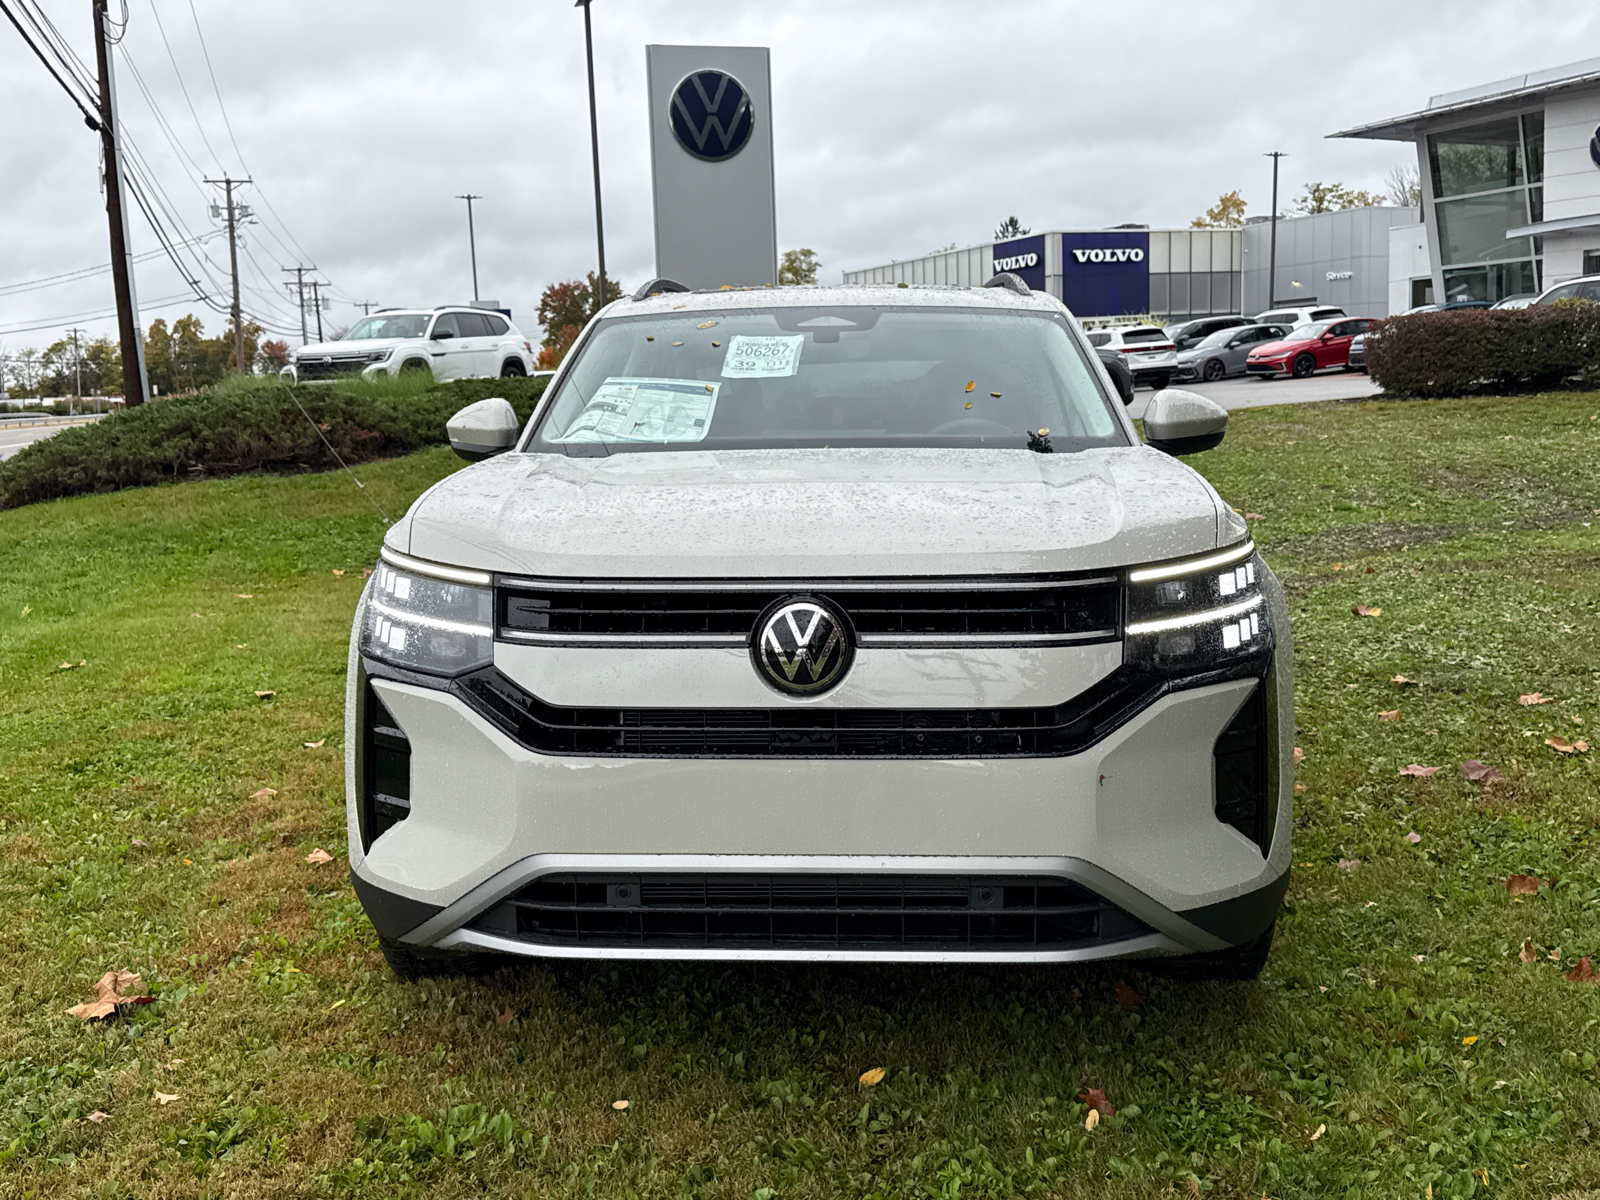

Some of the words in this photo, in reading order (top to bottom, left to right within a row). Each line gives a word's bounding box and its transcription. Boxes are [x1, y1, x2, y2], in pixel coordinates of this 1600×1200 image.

[994, 253, 1038, 271] VOLVO
[1073, 249, 1144, 263] VOLVO
[735, 345, 790, 357] 506267
[765, 609, 841, 682] VW
